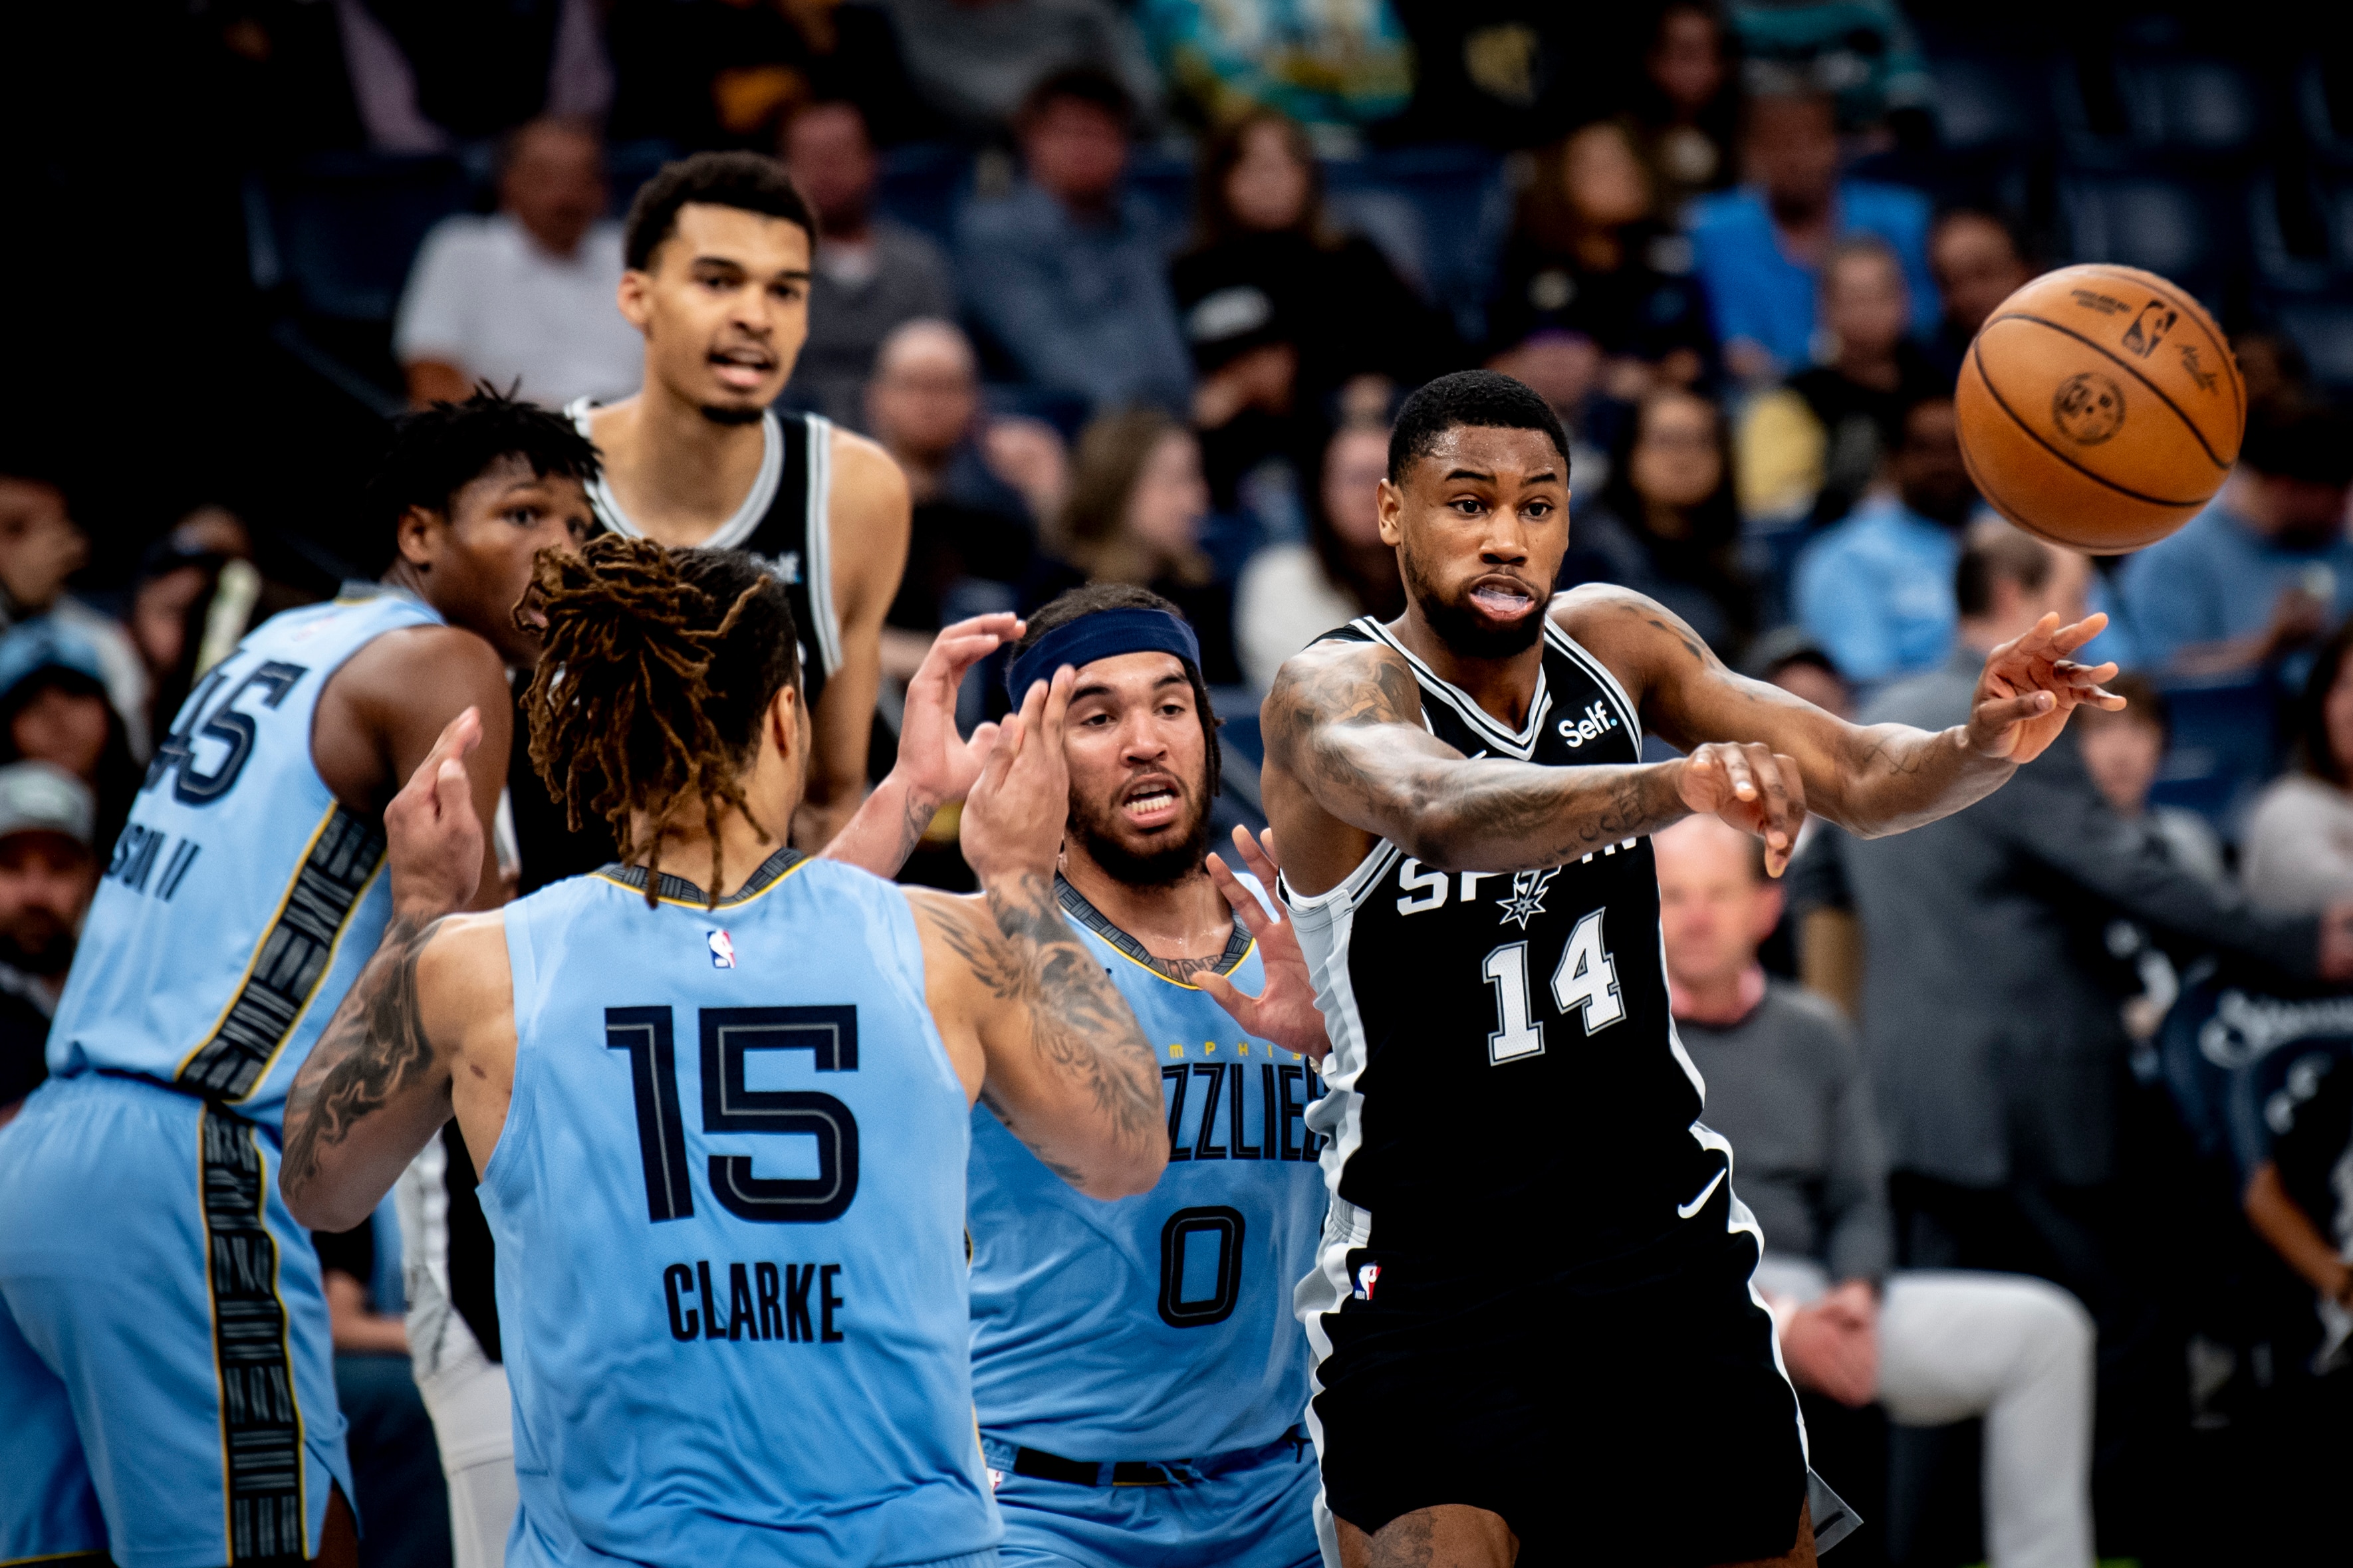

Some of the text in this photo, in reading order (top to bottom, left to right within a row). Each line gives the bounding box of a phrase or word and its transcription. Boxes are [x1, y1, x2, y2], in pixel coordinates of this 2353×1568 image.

[142, 647, 310, 808] 45
[1482, 907, 1626, 1066] 14
[604, 1004, 859, 1224] 15
[663, 1260, 844, 1344] CLARKE
[1158, 1205, 1245, 1329] 0
